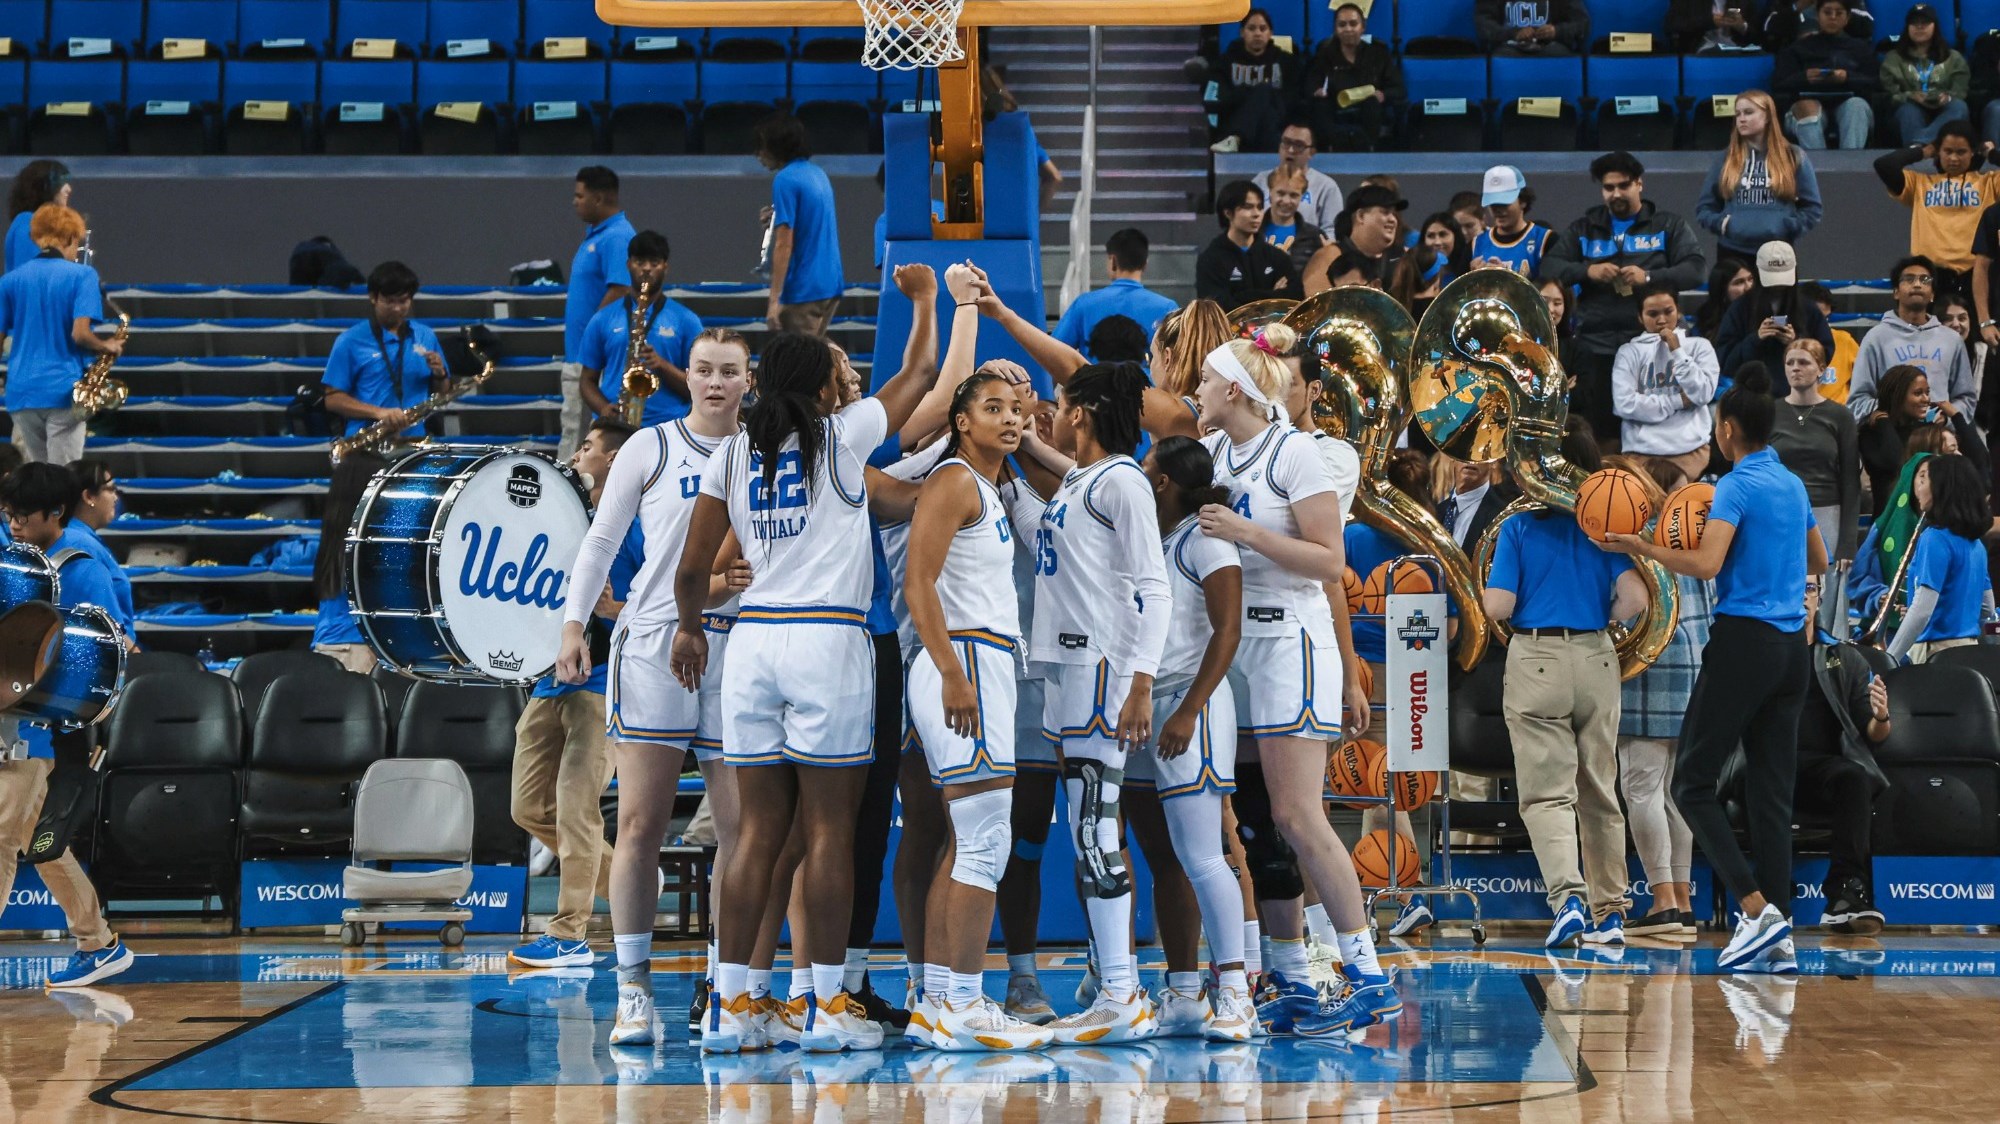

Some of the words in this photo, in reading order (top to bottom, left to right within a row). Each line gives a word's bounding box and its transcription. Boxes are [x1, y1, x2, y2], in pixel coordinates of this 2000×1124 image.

[1925, 189, 1980, 207] BRUINS
[1768, 259, 1786, 267] UCLA
[1895, 344, 1943, 363] UCLA
[510, 482, 538, 495] MAPEX
[748, 449, 808, 511] 22
[459, 522, 566, 611] Ucla
[492, 659, 520, 670] REMO
[1409, 670, 1428, 751] Wilson
[1344, 744, 1362, 787] Wilson
[8, 889, 49, 906] COM
[257, 883, 341, 902] WESCOM
[1889, 883, 1974, 900] WESCOM
